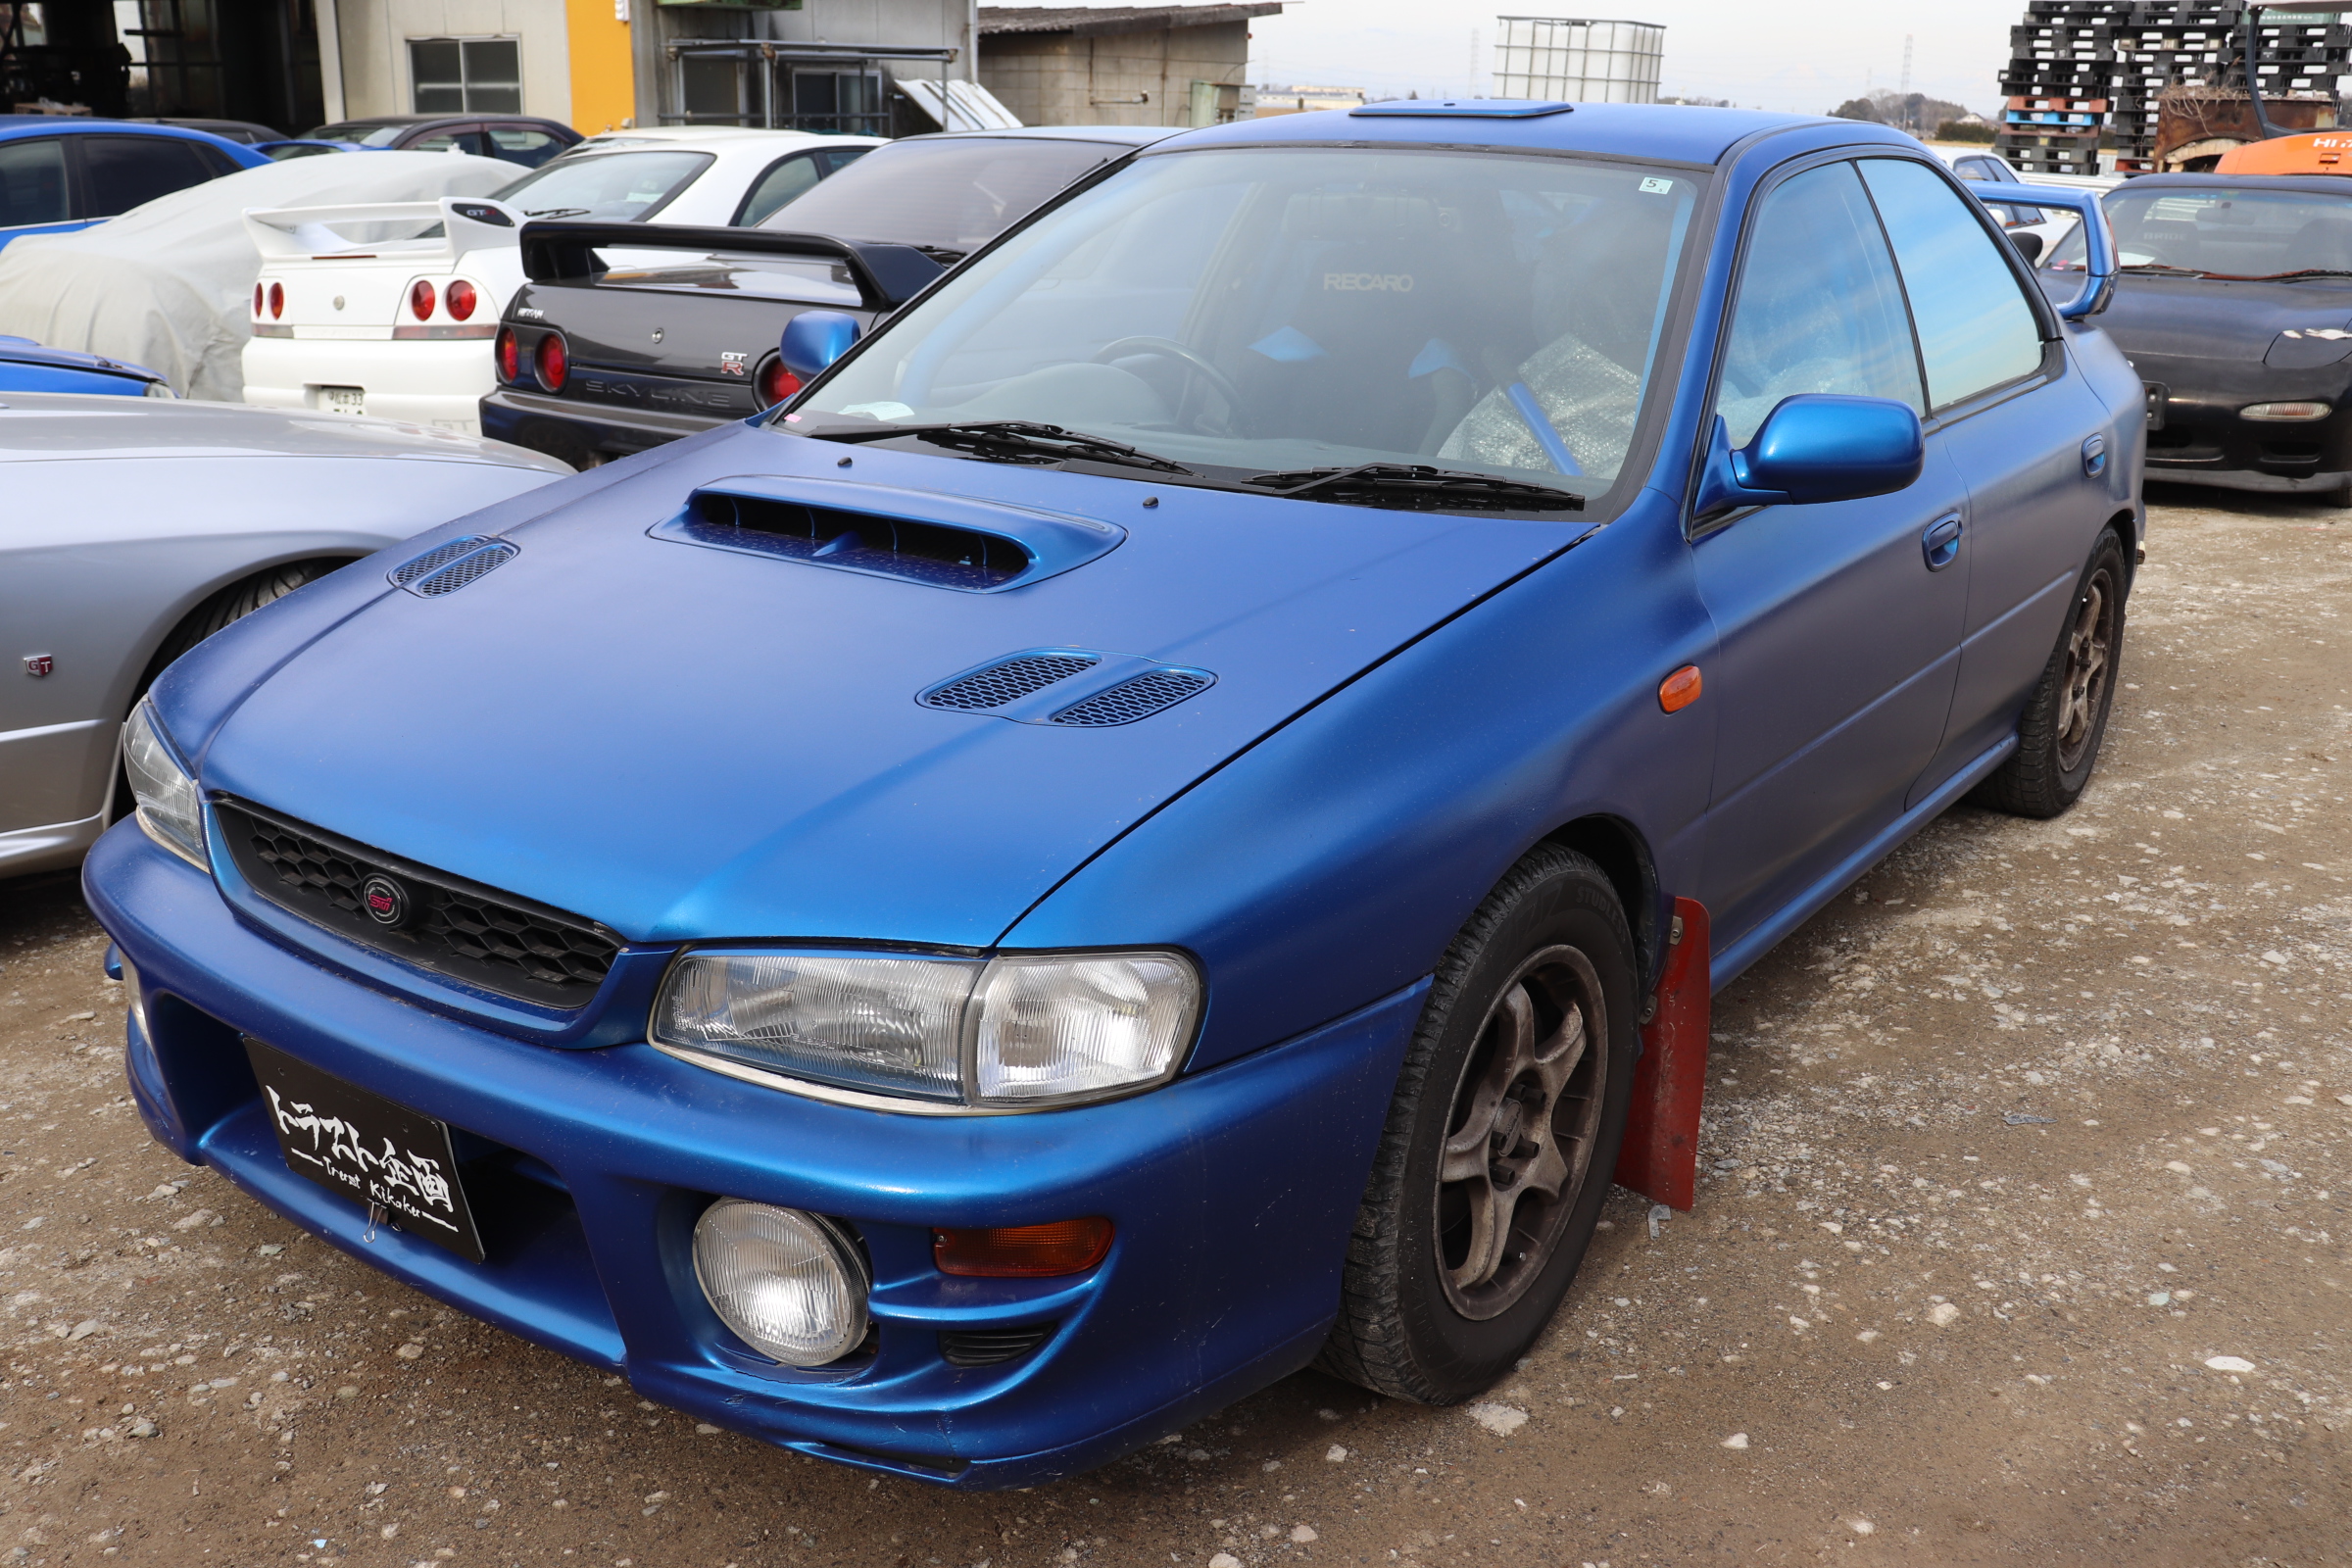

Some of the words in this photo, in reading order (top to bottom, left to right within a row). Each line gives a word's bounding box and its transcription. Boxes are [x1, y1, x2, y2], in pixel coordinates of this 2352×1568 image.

[1323, 273, 1413, 292] RECARO
[721, 352, 748, 362] GT
[721, 362, 744, 375] R
[585, 379, 730, 408] SKYLINE
[28, 660, 51, 673] GT
[1575, 885, 1627, 945] STUDLESS
